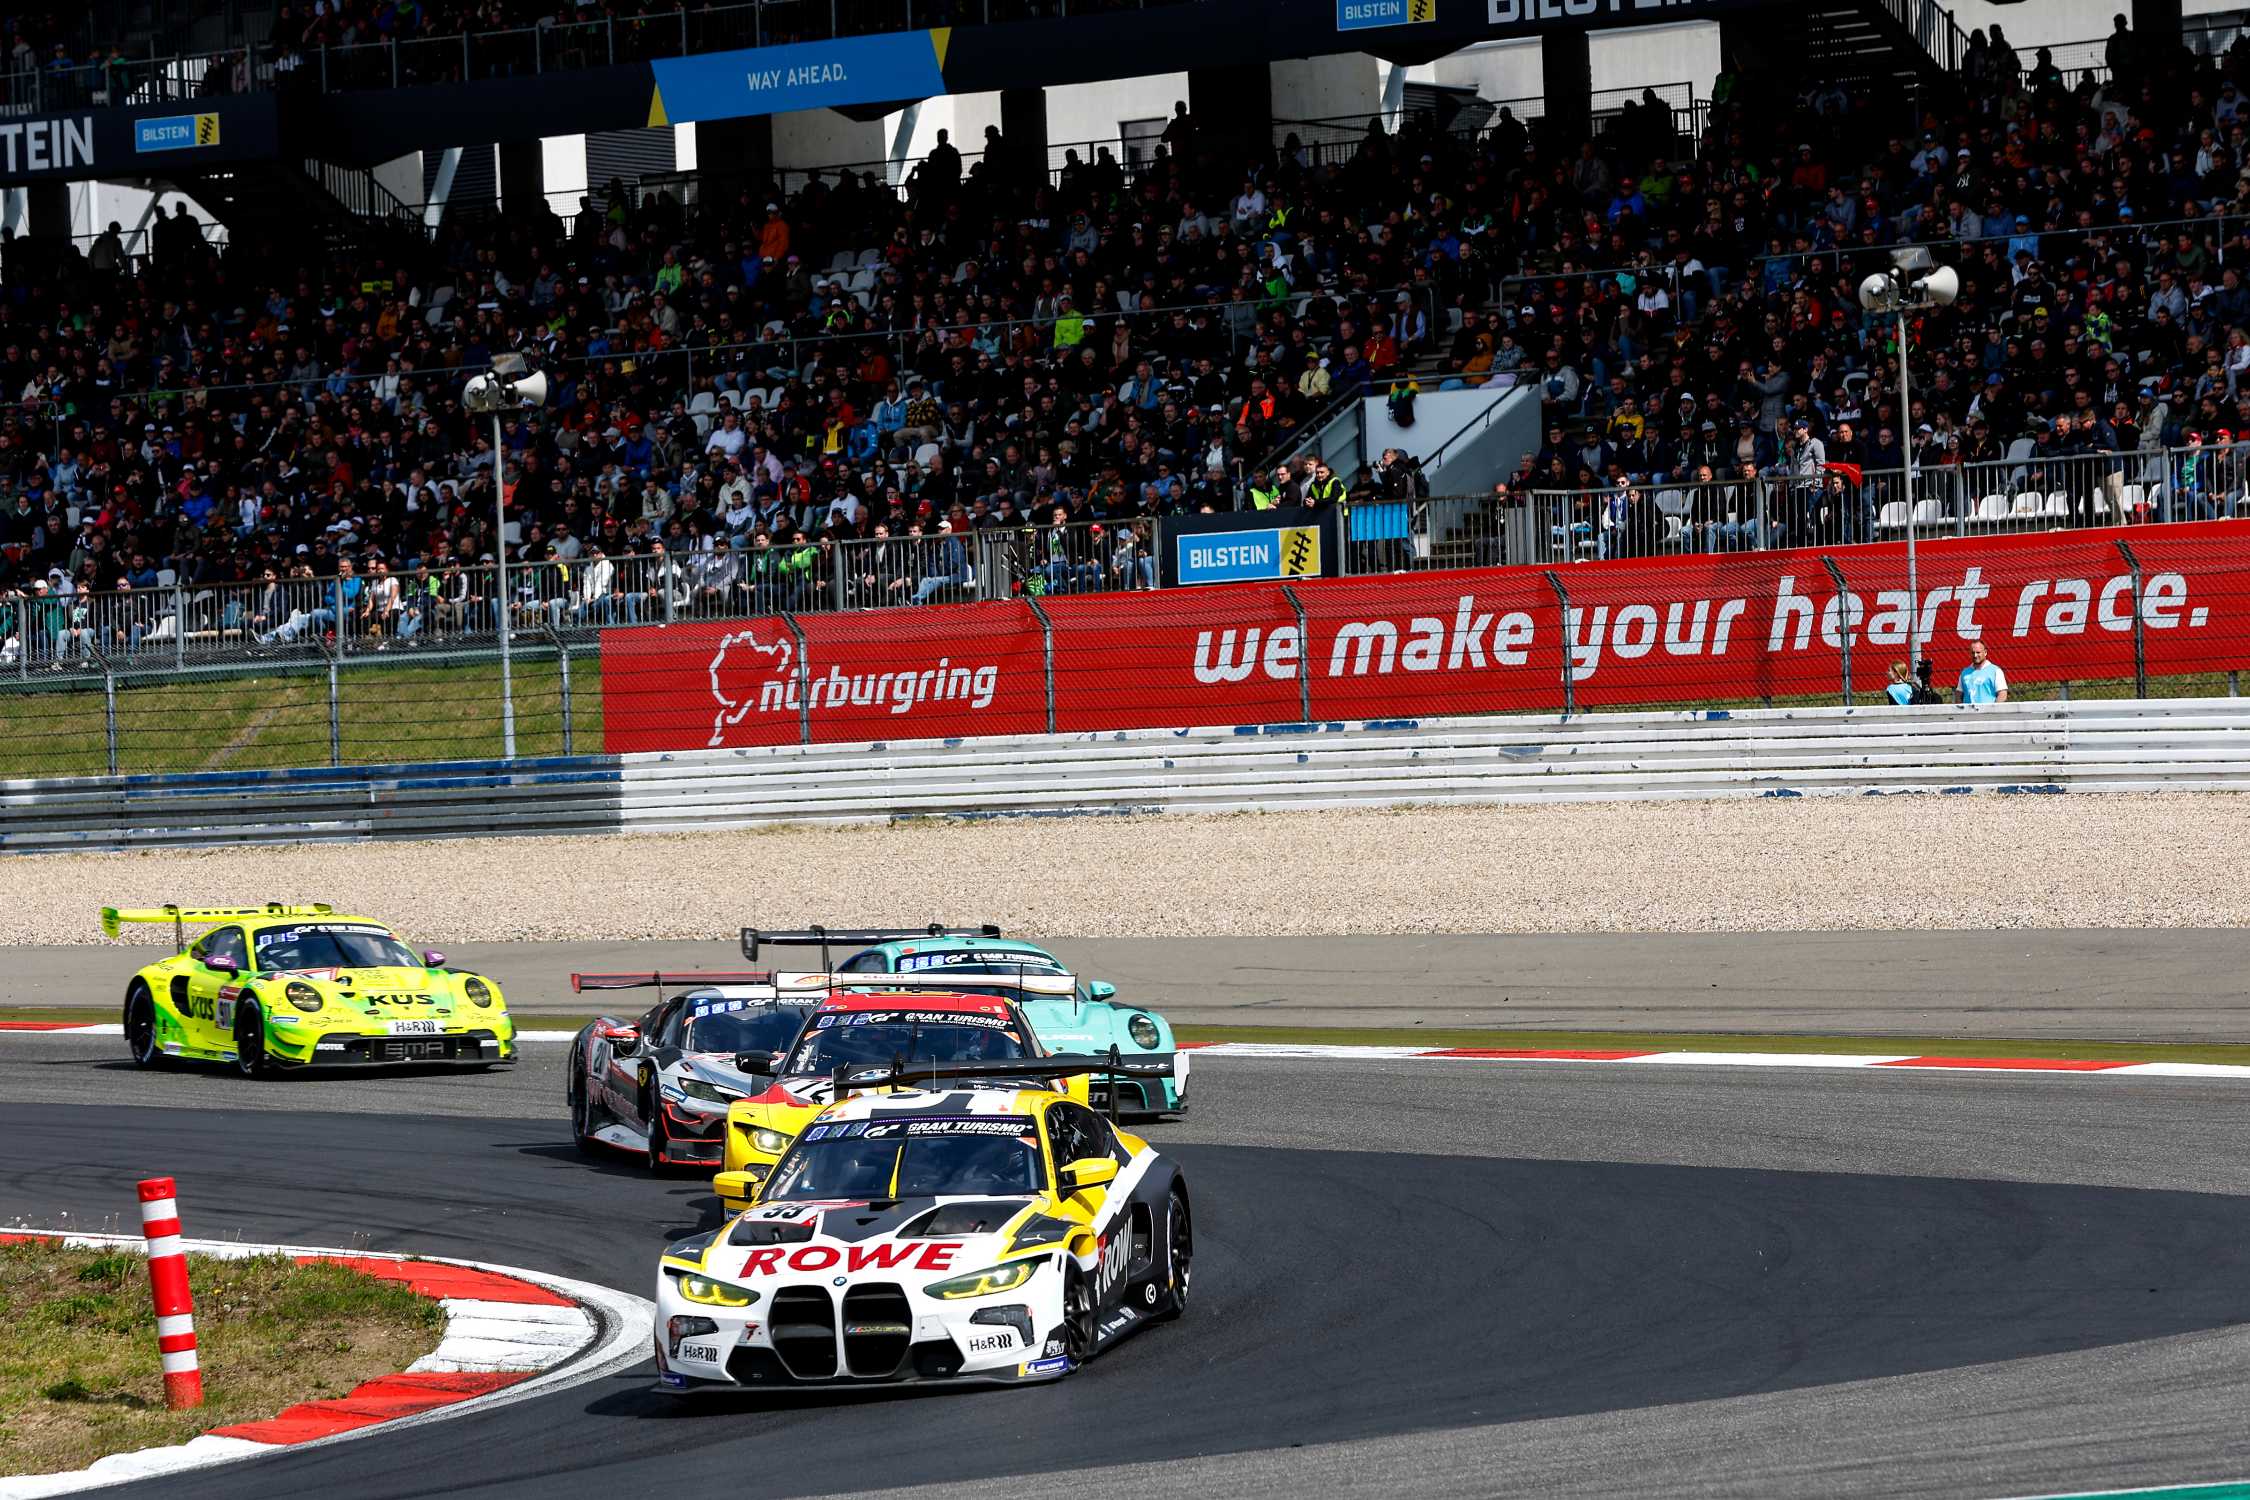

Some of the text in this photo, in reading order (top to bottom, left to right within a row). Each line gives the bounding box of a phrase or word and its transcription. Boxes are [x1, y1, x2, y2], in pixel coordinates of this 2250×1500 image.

[1345, 1, 1400, 20] BILSTEIN
[748, 64, 847, 90] WAY AHEAD.
[142, 124, 189, 142] BILSTEIN
[1190, 544, 1269, 569] BILSTEIN
[1194, 566, 2209, 684] we make your heart race.
[904, 1012, 946, 1021] GRAN
[947, 1014, 1008, 1027] TURISMO
[908, 1121, 952, 1131] GRAN
[954, 1122, 1026, 1132] TURISMO
[738, 1243, 964, 1279] ROWE
[969, 1337, 997, 1352] H&R
